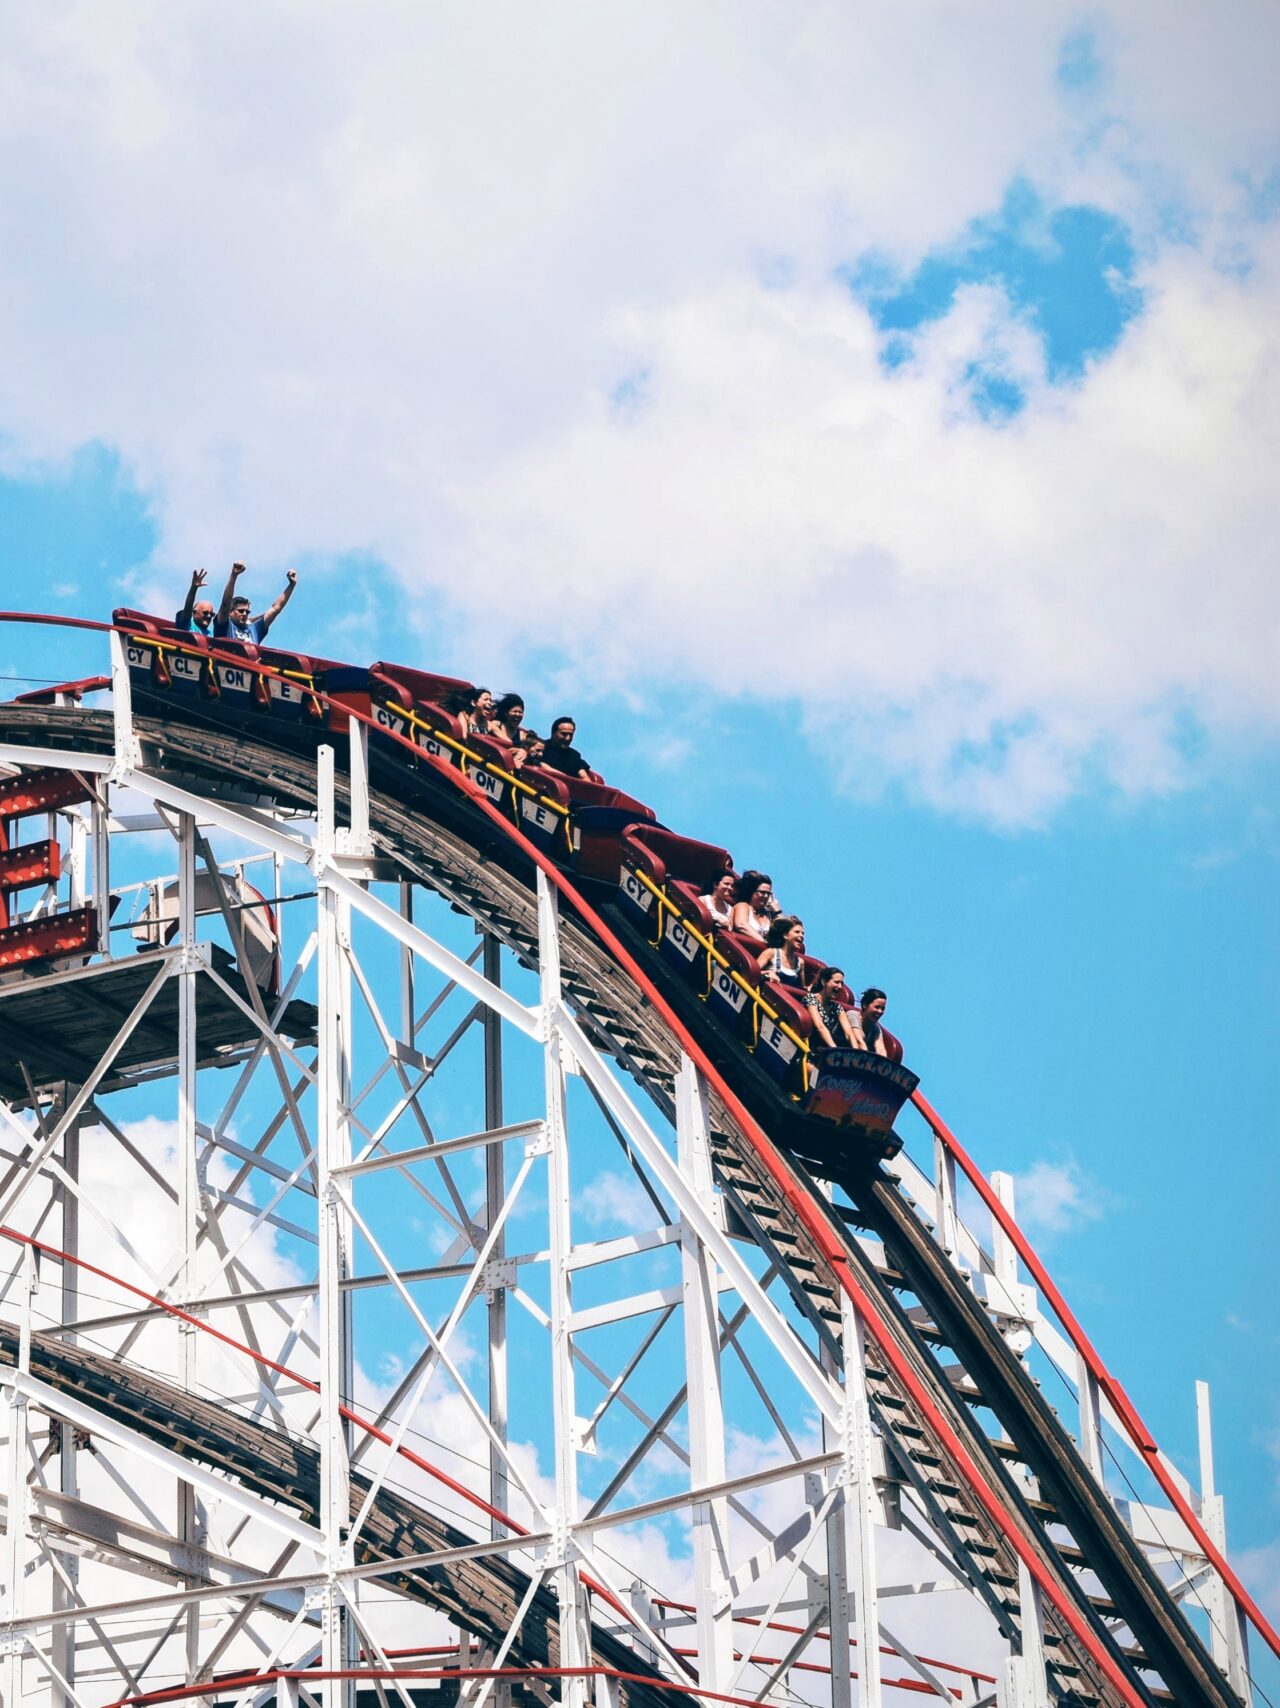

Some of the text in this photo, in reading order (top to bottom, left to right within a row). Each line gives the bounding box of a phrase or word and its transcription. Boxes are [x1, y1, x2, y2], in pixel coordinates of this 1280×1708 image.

[128, 648, 291, 698] CY CL ON E
[377, 710, 398, 729] CY
[476, 771, 496, 793] ON
[535, 807, 546, 825] E
[627, 876, 783, 1049] CY CL ON E
[826, 1051, 916, 1091] CYCLONE
